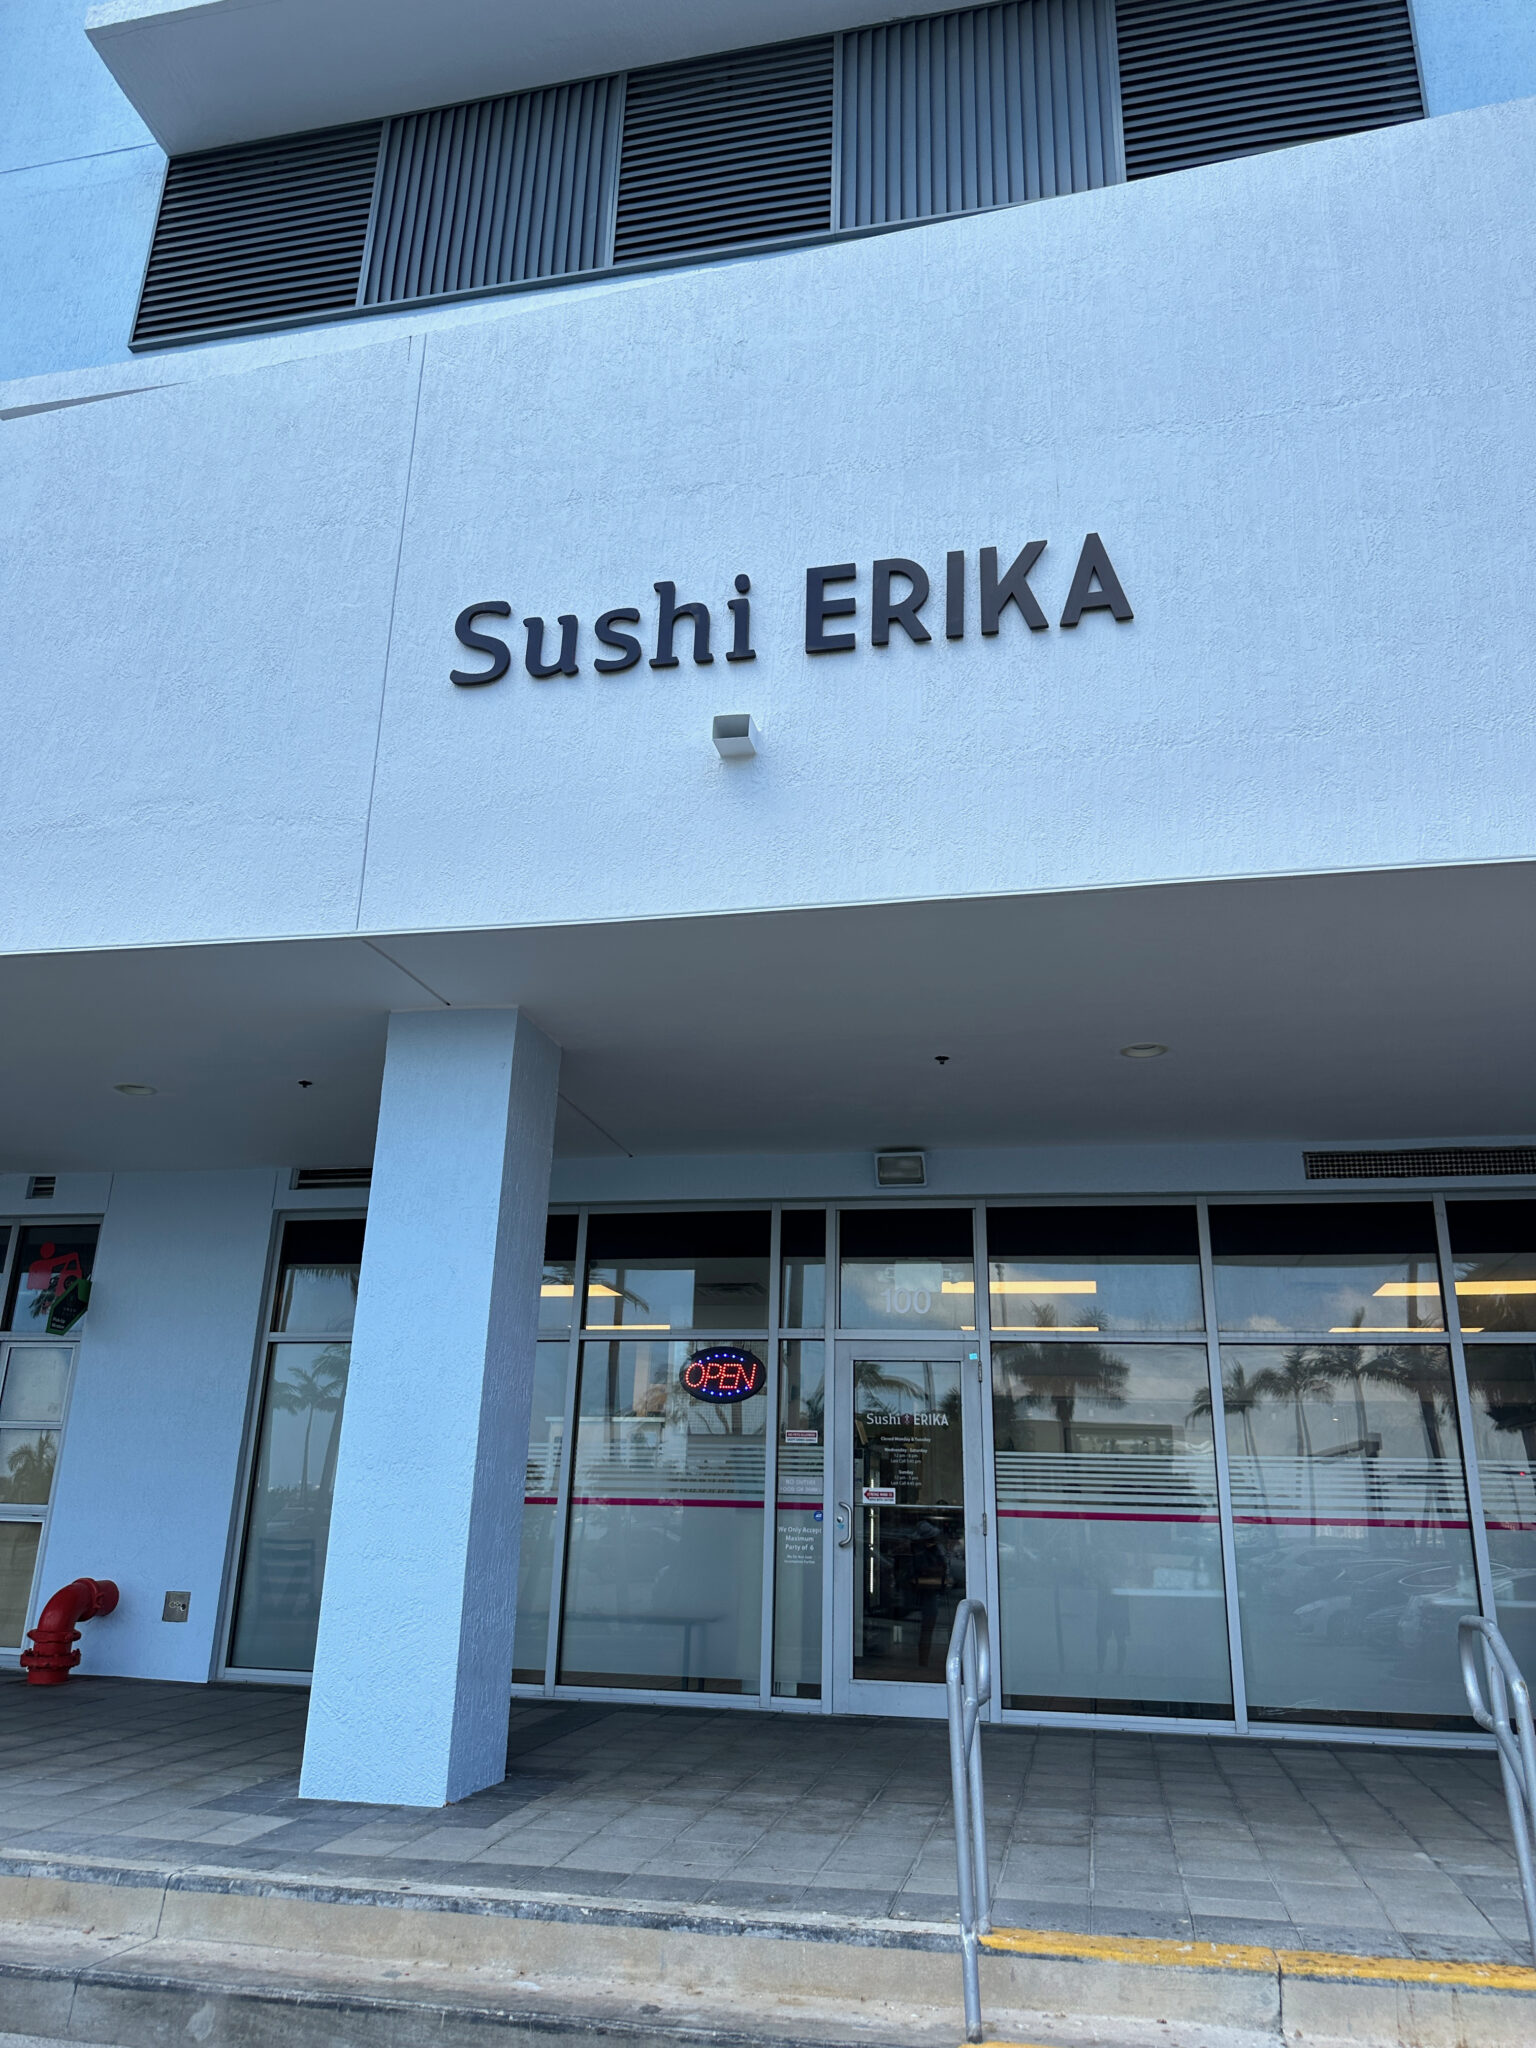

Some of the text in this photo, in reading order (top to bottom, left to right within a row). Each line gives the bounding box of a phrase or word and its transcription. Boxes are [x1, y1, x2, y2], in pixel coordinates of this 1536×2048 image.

[450, 532, 1134, 687] Sushi ERIKA
[880, 1287, 931, 1314] 100
[685, 1362, 757, 1390] OPEN
[866, 1413, 949, 1426] Sushi ERIKA
[788, 1526, 802, 1534] Only
[785, 1543, 801, 1552] Party
